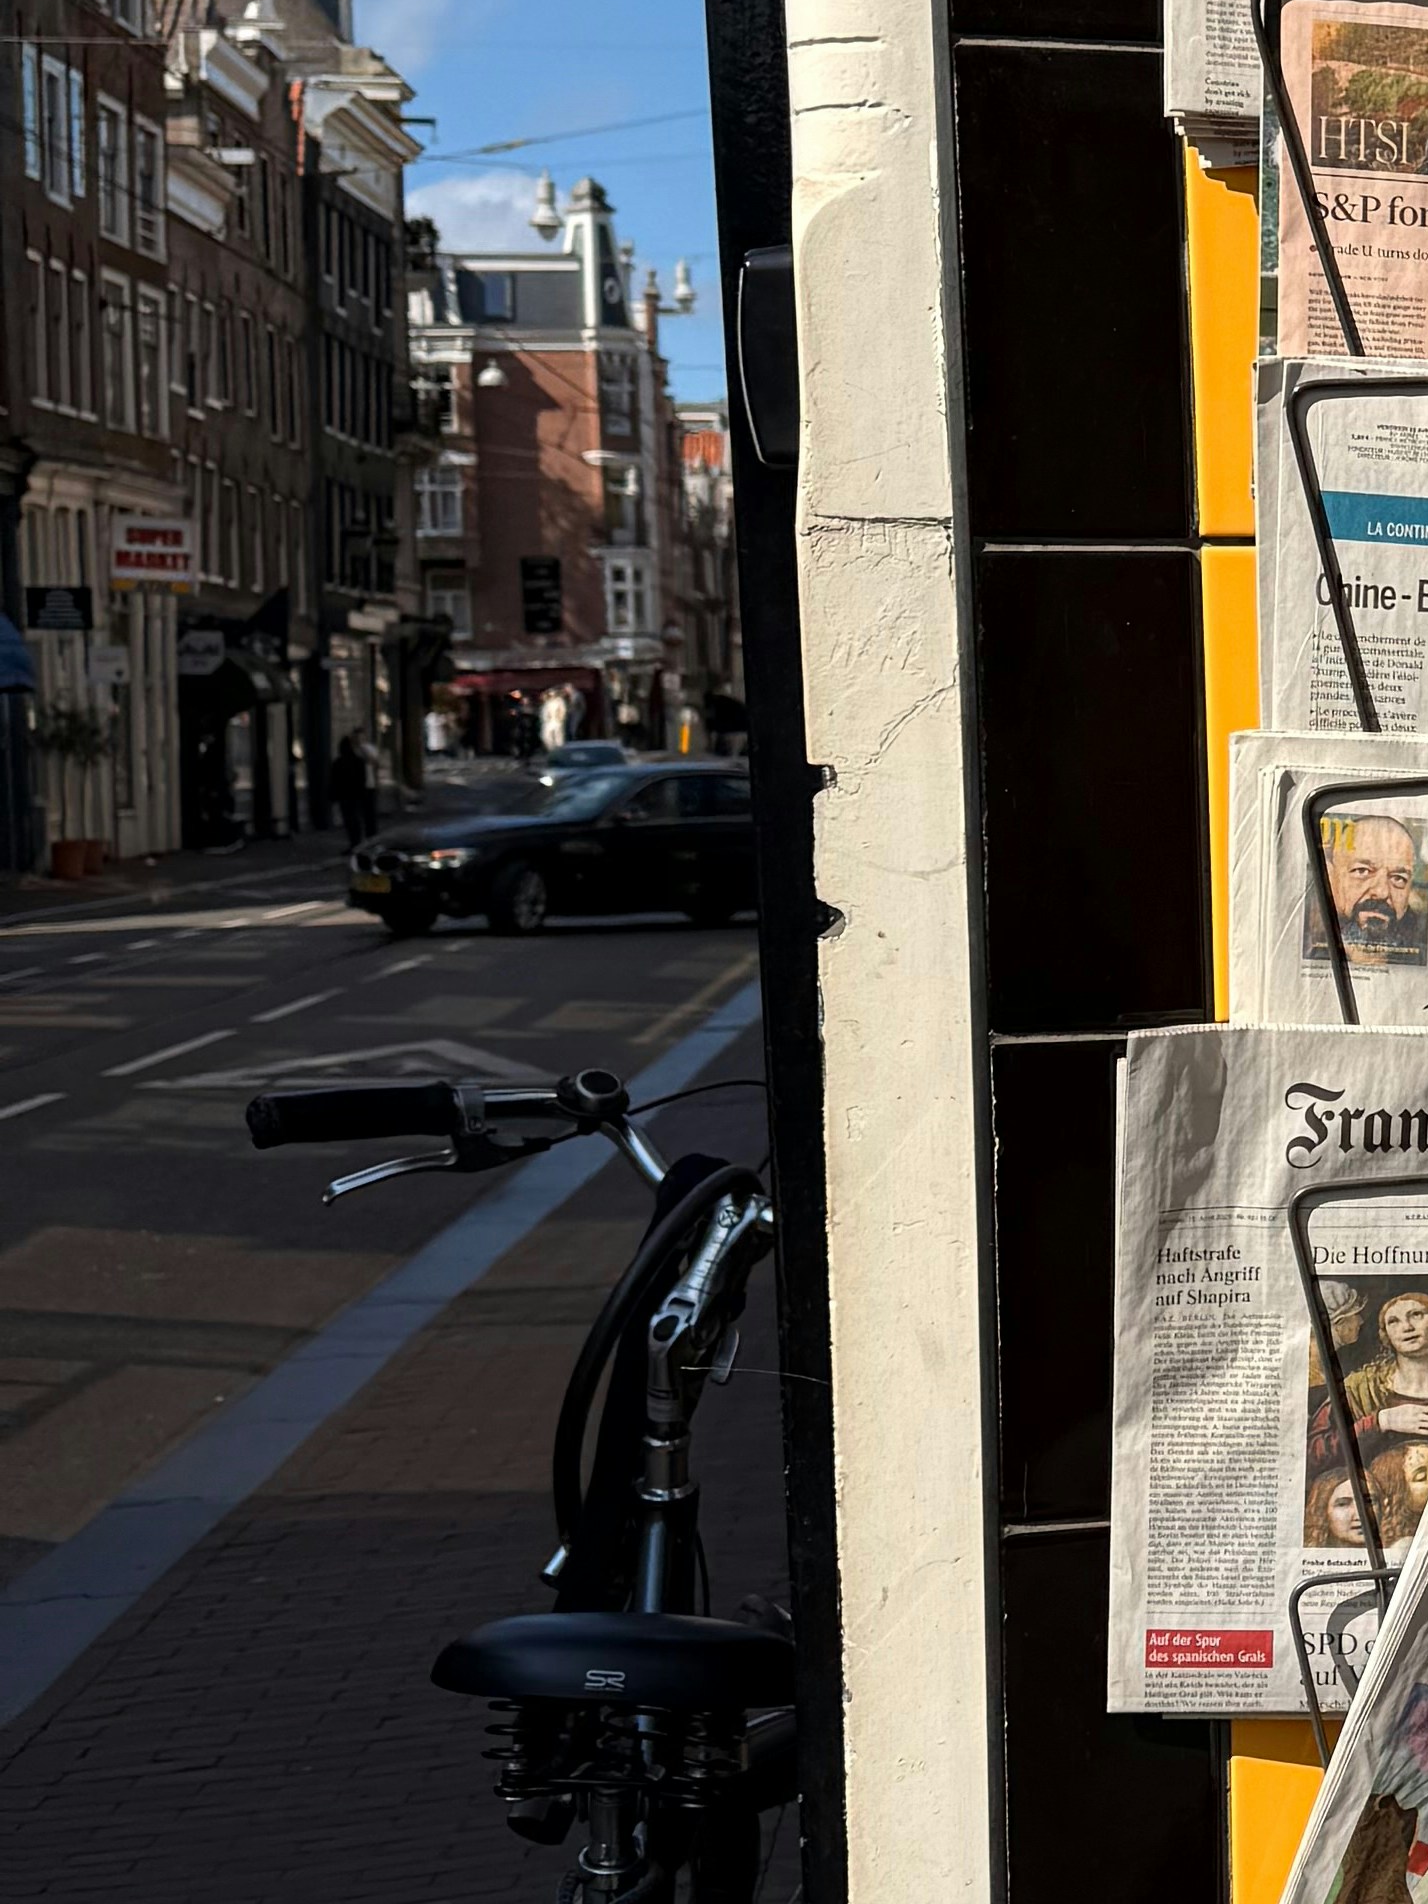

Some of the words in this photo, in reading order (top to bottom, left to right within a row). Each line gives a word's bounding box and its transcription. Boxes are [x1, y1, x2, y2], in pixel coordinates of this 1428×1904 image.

[1319, 116, 1413, 164] HTSI
[1314, 190, 1382, 224] S&P
[1157, 1245, 1241, 1263] Haftstrafe
[1313, 1246, 1346, 1264] Die
[1156, 1270, 1196, 1285] nach
[1200, 1267, 1261, 1286] Angriff
[1187, 1290, 1251, 1308] Shapira
[1149, 1633, 1169, 1646] Auf
[1173, 1634, 1192, 1646] der
[1196, 1633, 1221, 1649] Spur
[1173, 1650, 1234, 1665] spanischen
